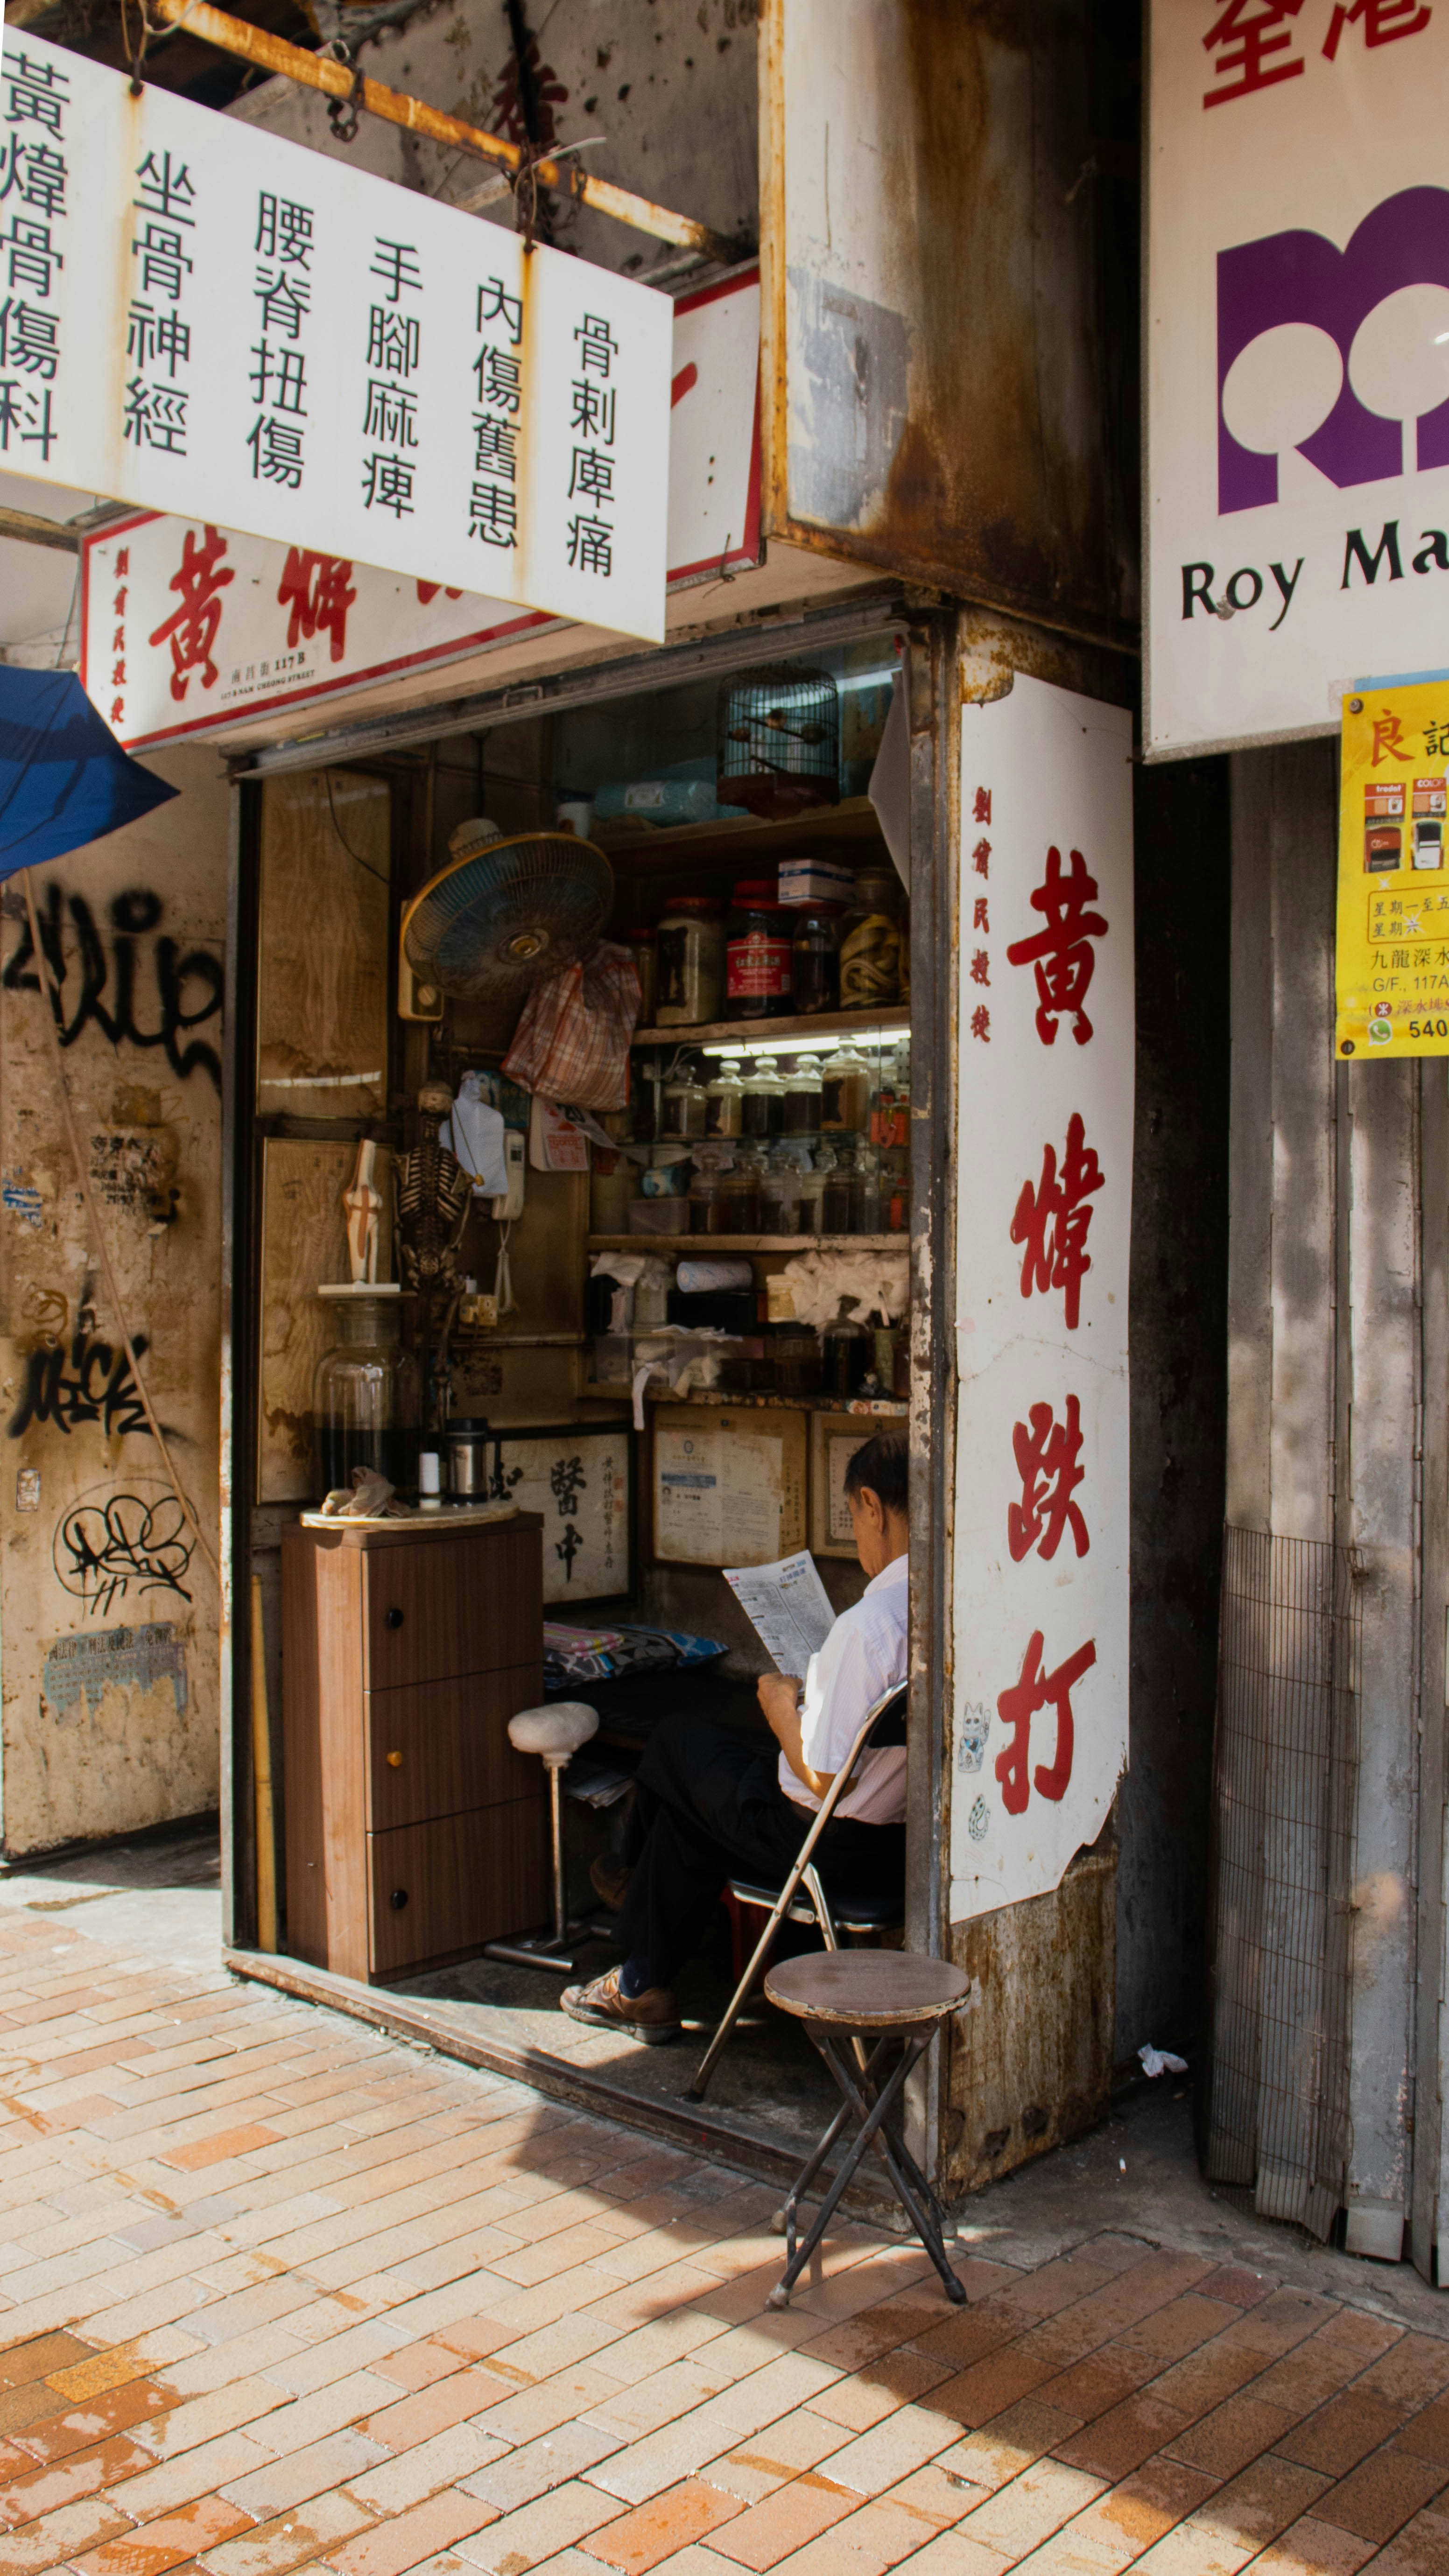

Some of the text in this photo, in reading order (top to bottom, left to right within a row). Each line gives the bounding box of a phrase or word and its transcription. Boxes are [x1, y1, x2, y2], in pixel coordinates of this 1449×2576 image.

[0, 50, 70, 462] 黃煒骨傷科
[123, 149, 196, 456] 坐骨神經
[246, 190, 315, 490] 腰脊扭傷
[361, 235, 423, 519] 手腳麻痺
[468, 275, 524, 549] 內傷舊患
[257, 677, 286, 691] CHEONG
[287, 669, 315, 682] STREET
[1181, 557, 1306, 632] Roy
[997, 845, 1109, 1815] 黃煒跌打
